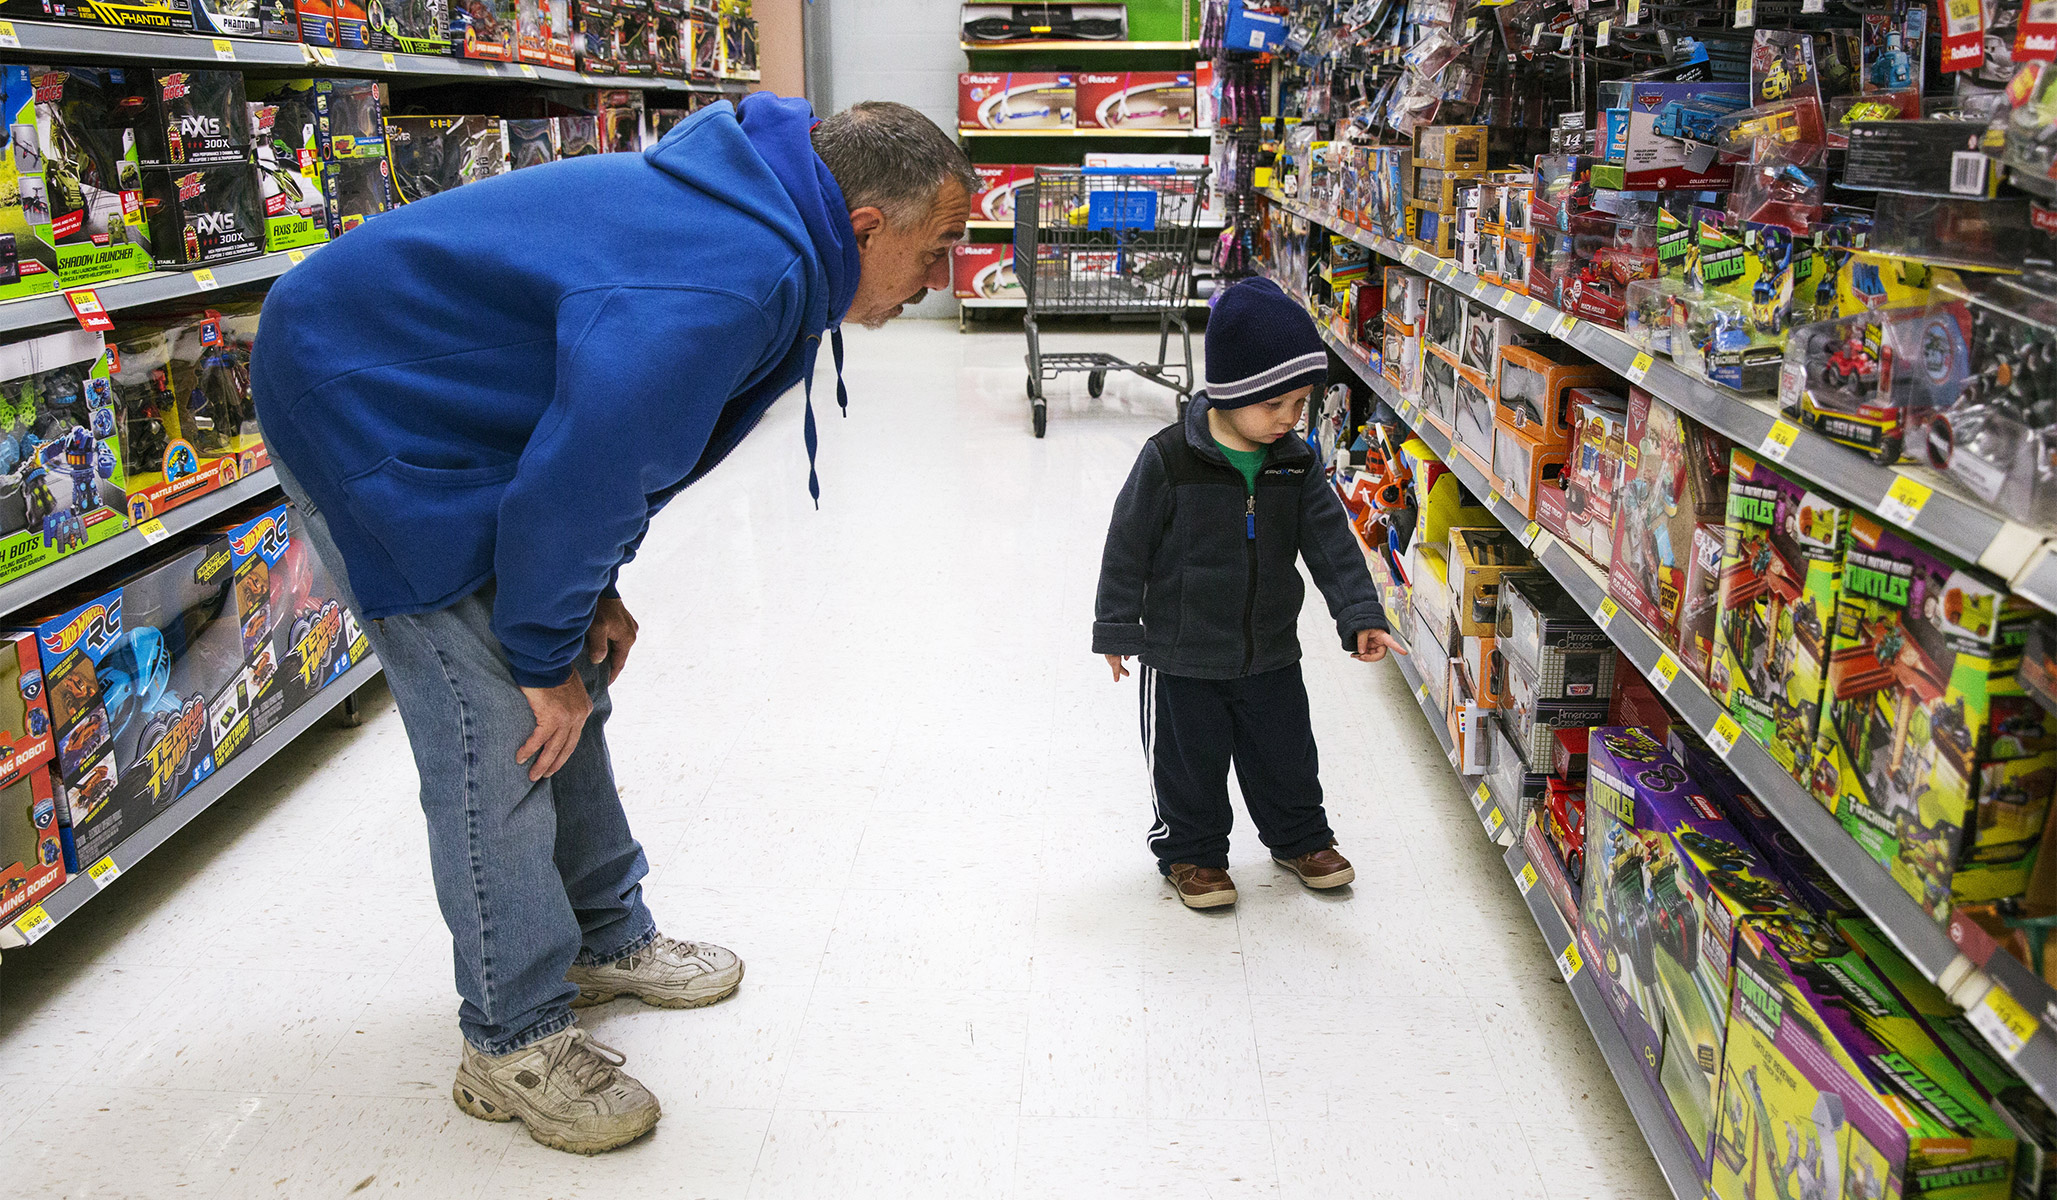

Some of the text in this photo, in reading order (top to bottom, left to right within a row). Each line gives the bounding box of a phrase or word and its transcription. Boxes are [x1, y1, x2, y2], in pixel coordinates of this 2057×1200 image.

[121, 12, 171, 26] PHANTOM
[41, 73, 58, 86] AIR
[166, 72, 182, 86] AIR
[969, 75, 1001, 84] Razor
[1087, 75, 1118, 84] Razor
[35, 85, 63, 103] HOGS
[163, 85, 185, 101] HOGS
[181, 115, 221, 137] AXIS
[204, 139, 230, 149] 300X
[1563, 133, 1582, 146] 14
[182, 172, 197, 186] AIR
[179, 184, 201, 202] HOGS
[197, 211, 236, 235] AXIS
[273, 221, 307, 237] AXIS 200
[220, 233, 245, 244] 300X
[1659, 238, 1689, 261] TURTLES
[58, 254, 95, 269] SHADOW
[95, 248, 133, 264] LAUNCHER
[964, 247, 994, 255] Razor
[1703, 255, 1745, 281] TURTLES
[1793, 257, 1813, 279] TLES
[206, 325, 211, 333] 2
[150, 486, 172, 500] BATTLE
[173, 476, 196, 491] BOXING
[196, 467, 219, 481] ROBOTS
[1729, 493, 1775, 525] TURTLES
[262, 511, 288, 555] RC
[10, 536, 40, 559] BOTS
[1661, 585, 1678, 599] STORY
[1844, 562, 1911, 607] TURTLES
[59, 606, 104, 652] HOT WHEELS
[86, 596, 122, 651] RC
[297, 606, 339, 662] TERRAIN
[299, 616, 340, 685] TWISTER
[1558, 638, 1593, 649] Classics
[1549, 716, 1585, 727] Classics
[1559, 708, 1602, 720] American
[145, 702, 204, 773] TERRAIN
[214, 713, 249, 762] EVERYTHING
[15, 740, 47, 767] ROBOT
[145, 713, 203, 799] TWISTER
[1591, 775, 1635, 827] TURTLES
[27, 868, 59, 897] ROBOT
[1737, 967, 1782, 1027] TURTLES
[1878, 1052, 1980, 1127] TURTLES
